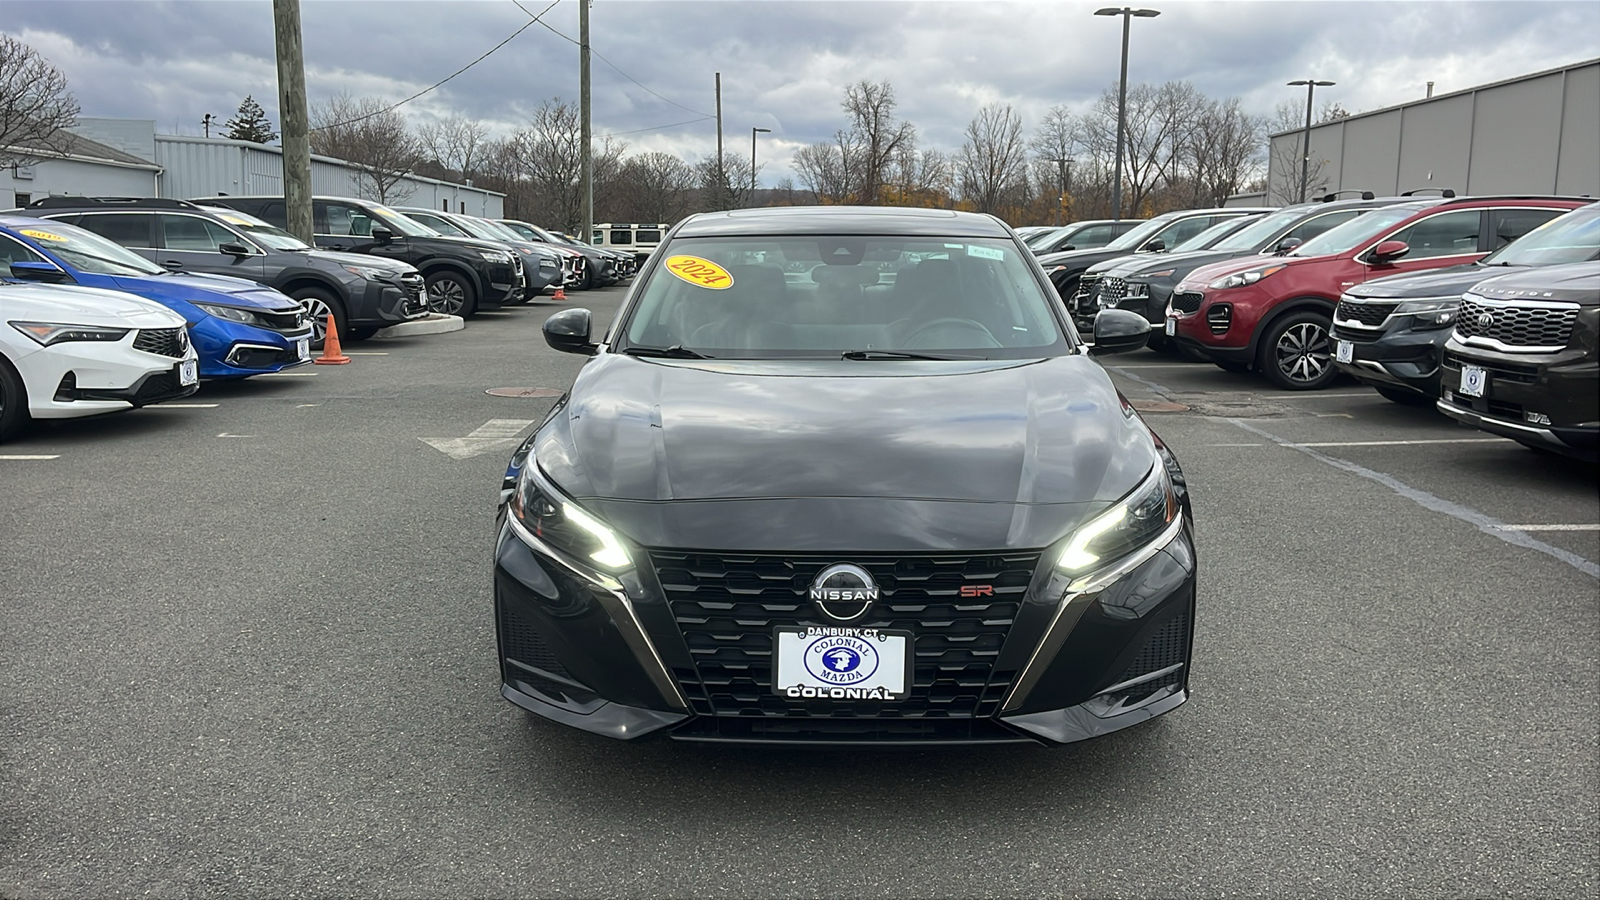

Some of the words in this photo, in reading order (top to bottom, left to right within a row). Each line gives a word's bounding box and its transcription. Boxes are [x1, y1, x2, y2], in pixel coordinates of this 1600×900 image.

[670, 259, 728, 284] 2024
[810, 590, 878, 600] NISSAN
[960, 585, 993, 597] SR
[807, 627, 861, 638] DANBURY,
[863, 629, 879, 638] CT
[814, 638, 870, 656] COLONIAL
[820, 669, 863, 682] MAZDA
[787, 686, 895, 700] COLONIAL
